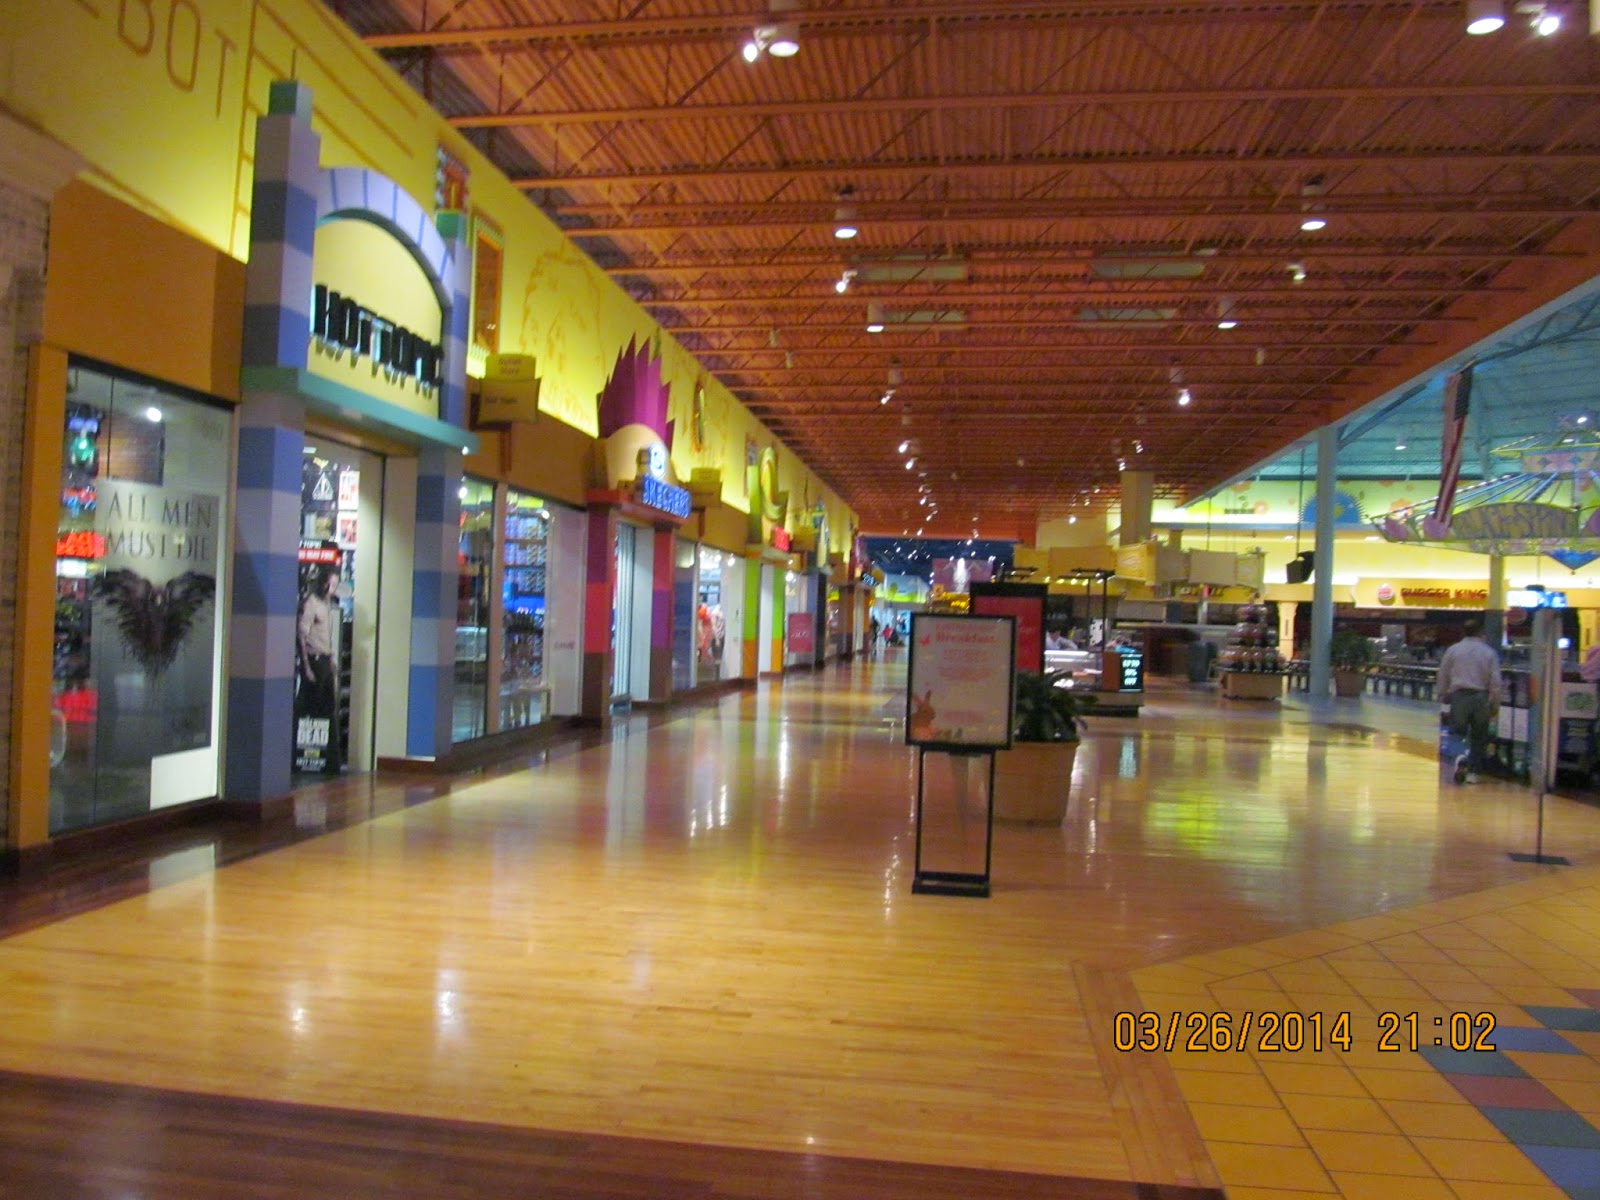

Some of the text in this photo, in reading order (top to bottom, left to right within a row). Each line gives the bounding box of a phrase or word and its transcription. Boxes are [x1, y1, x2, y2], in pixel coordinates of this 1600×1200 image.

[1400, 587, 1451, 598] BURGER
[1453, 588, 1488, 599] KING
[297, 729, 330, 747] DEAD
